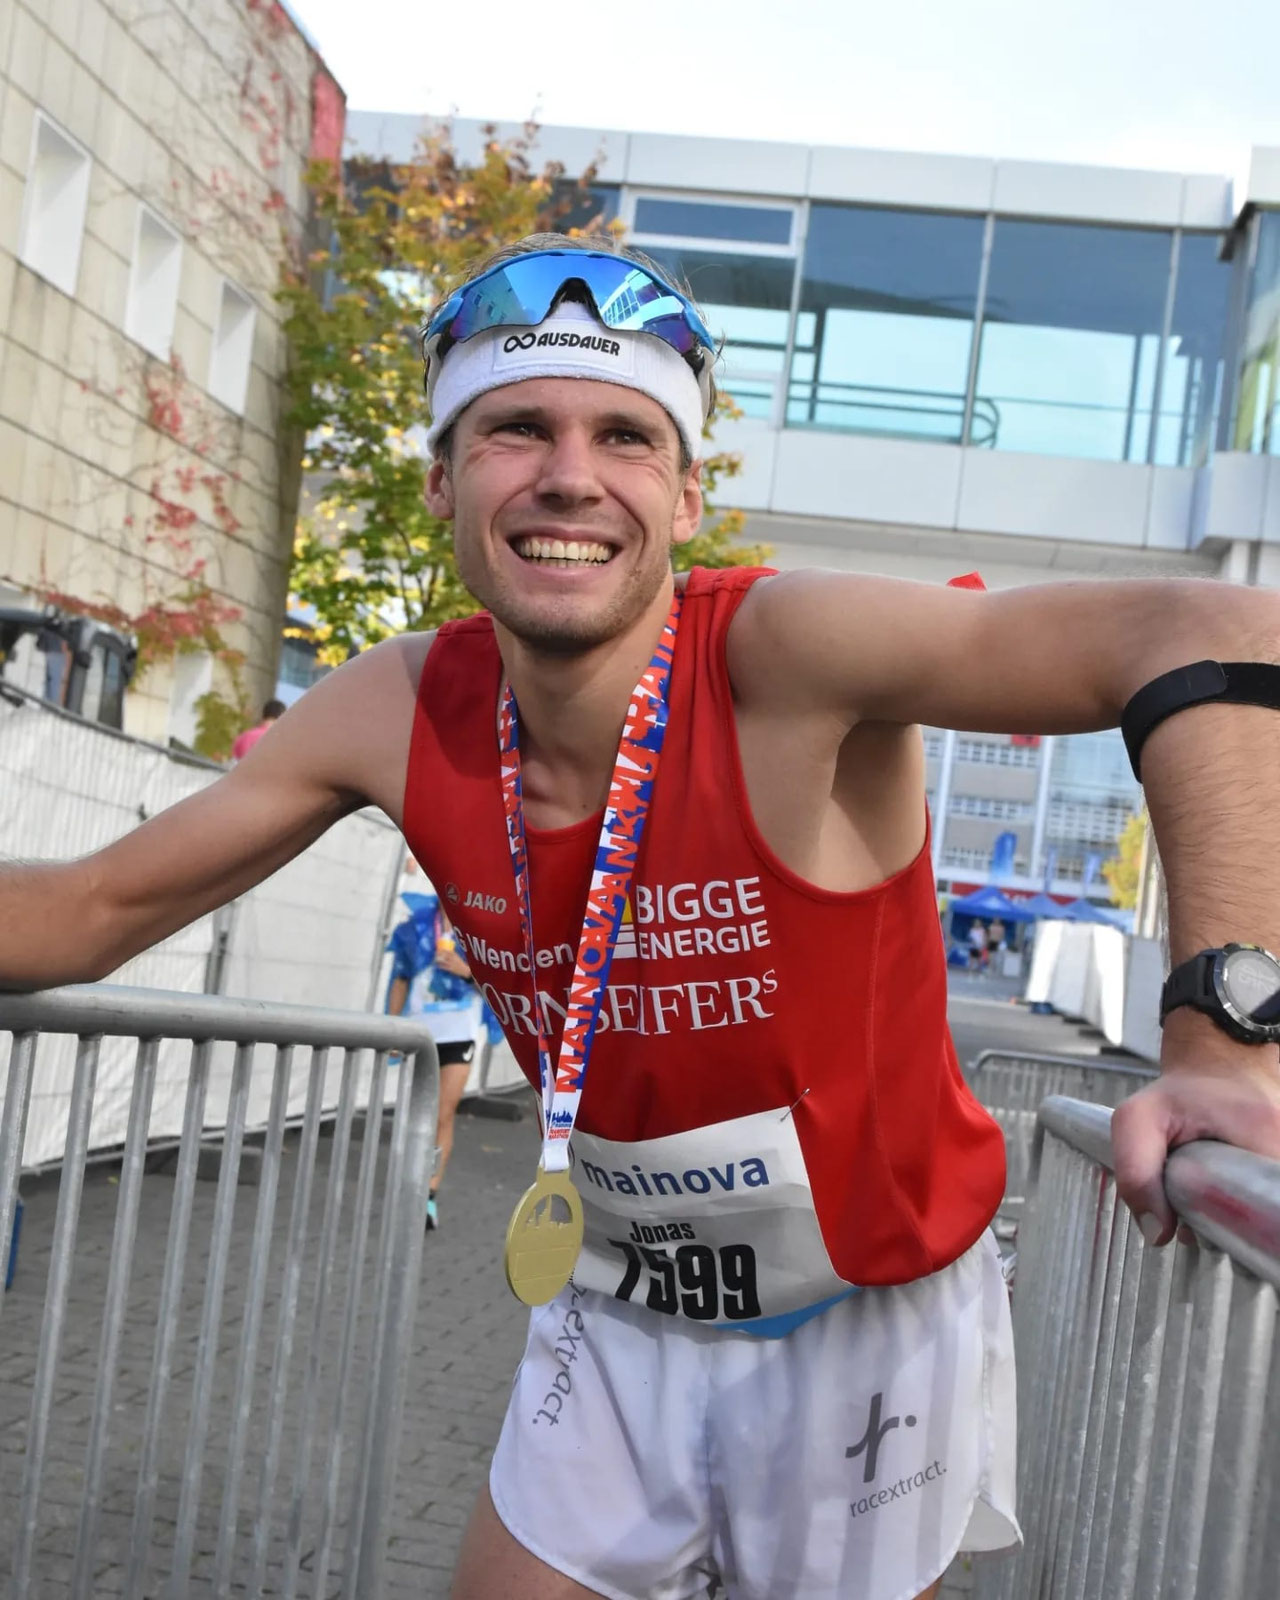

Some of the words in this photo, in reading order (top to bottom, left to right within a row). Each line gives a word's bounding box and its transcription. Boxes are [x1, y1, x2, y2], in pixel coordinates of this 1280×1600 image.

[537, 332, 620, 356] AUSDAUER
[463, 890, 507, 915] JAKO
[636, 876, 765, 924] BIGGE
[638, 920, 771, 960] ENERGIE
[580, 1157, 770, 1196] mainova
[629, 1221, 696, 1245] Jonas
[606, 1238, 762, 1320] 7599
[850, 1460, 948, 1518] racextract.
